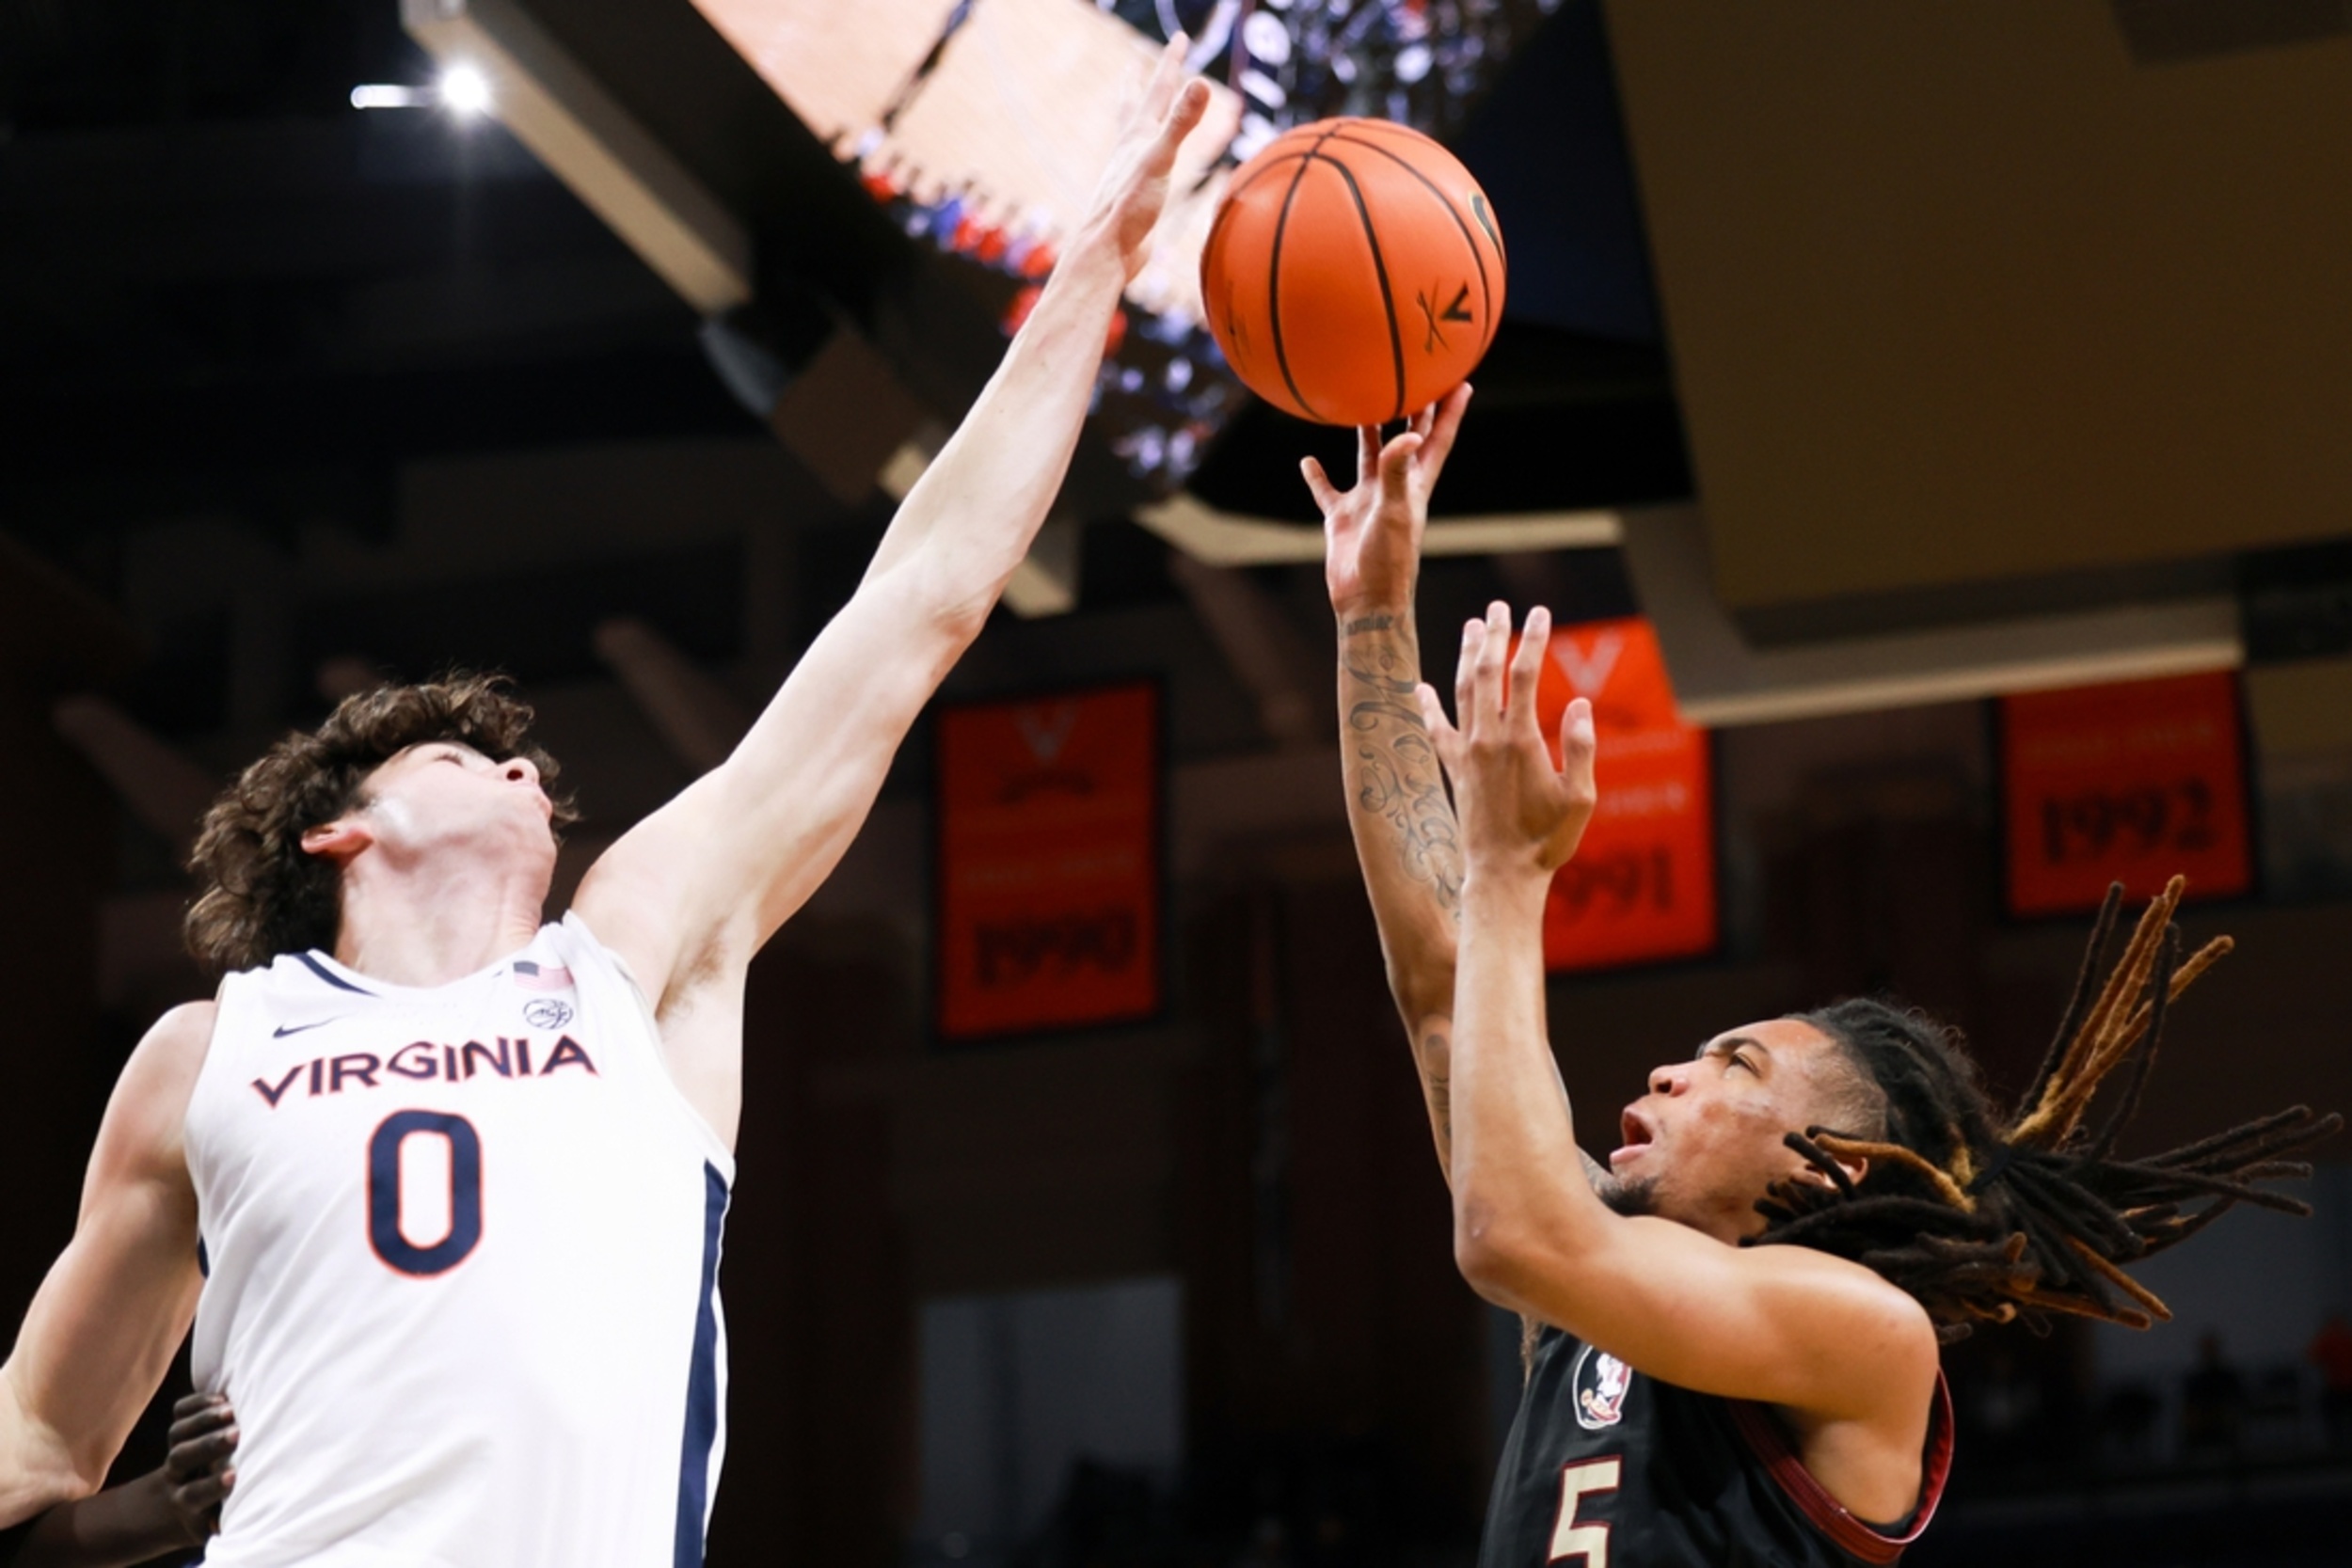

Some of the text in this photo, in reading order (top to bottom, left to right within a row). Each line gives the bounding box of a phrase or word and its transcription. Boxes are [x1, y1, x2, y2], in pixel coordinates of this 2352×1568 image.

[2042, 777, 2213, 866] 1992
[1554, 847, 1673, 922] 991
[250, 1034, 601, 1109] VIRGINIA
[366, 1108, 483, 1280] 0
[1547, 1454, 1622, 1568] 5
